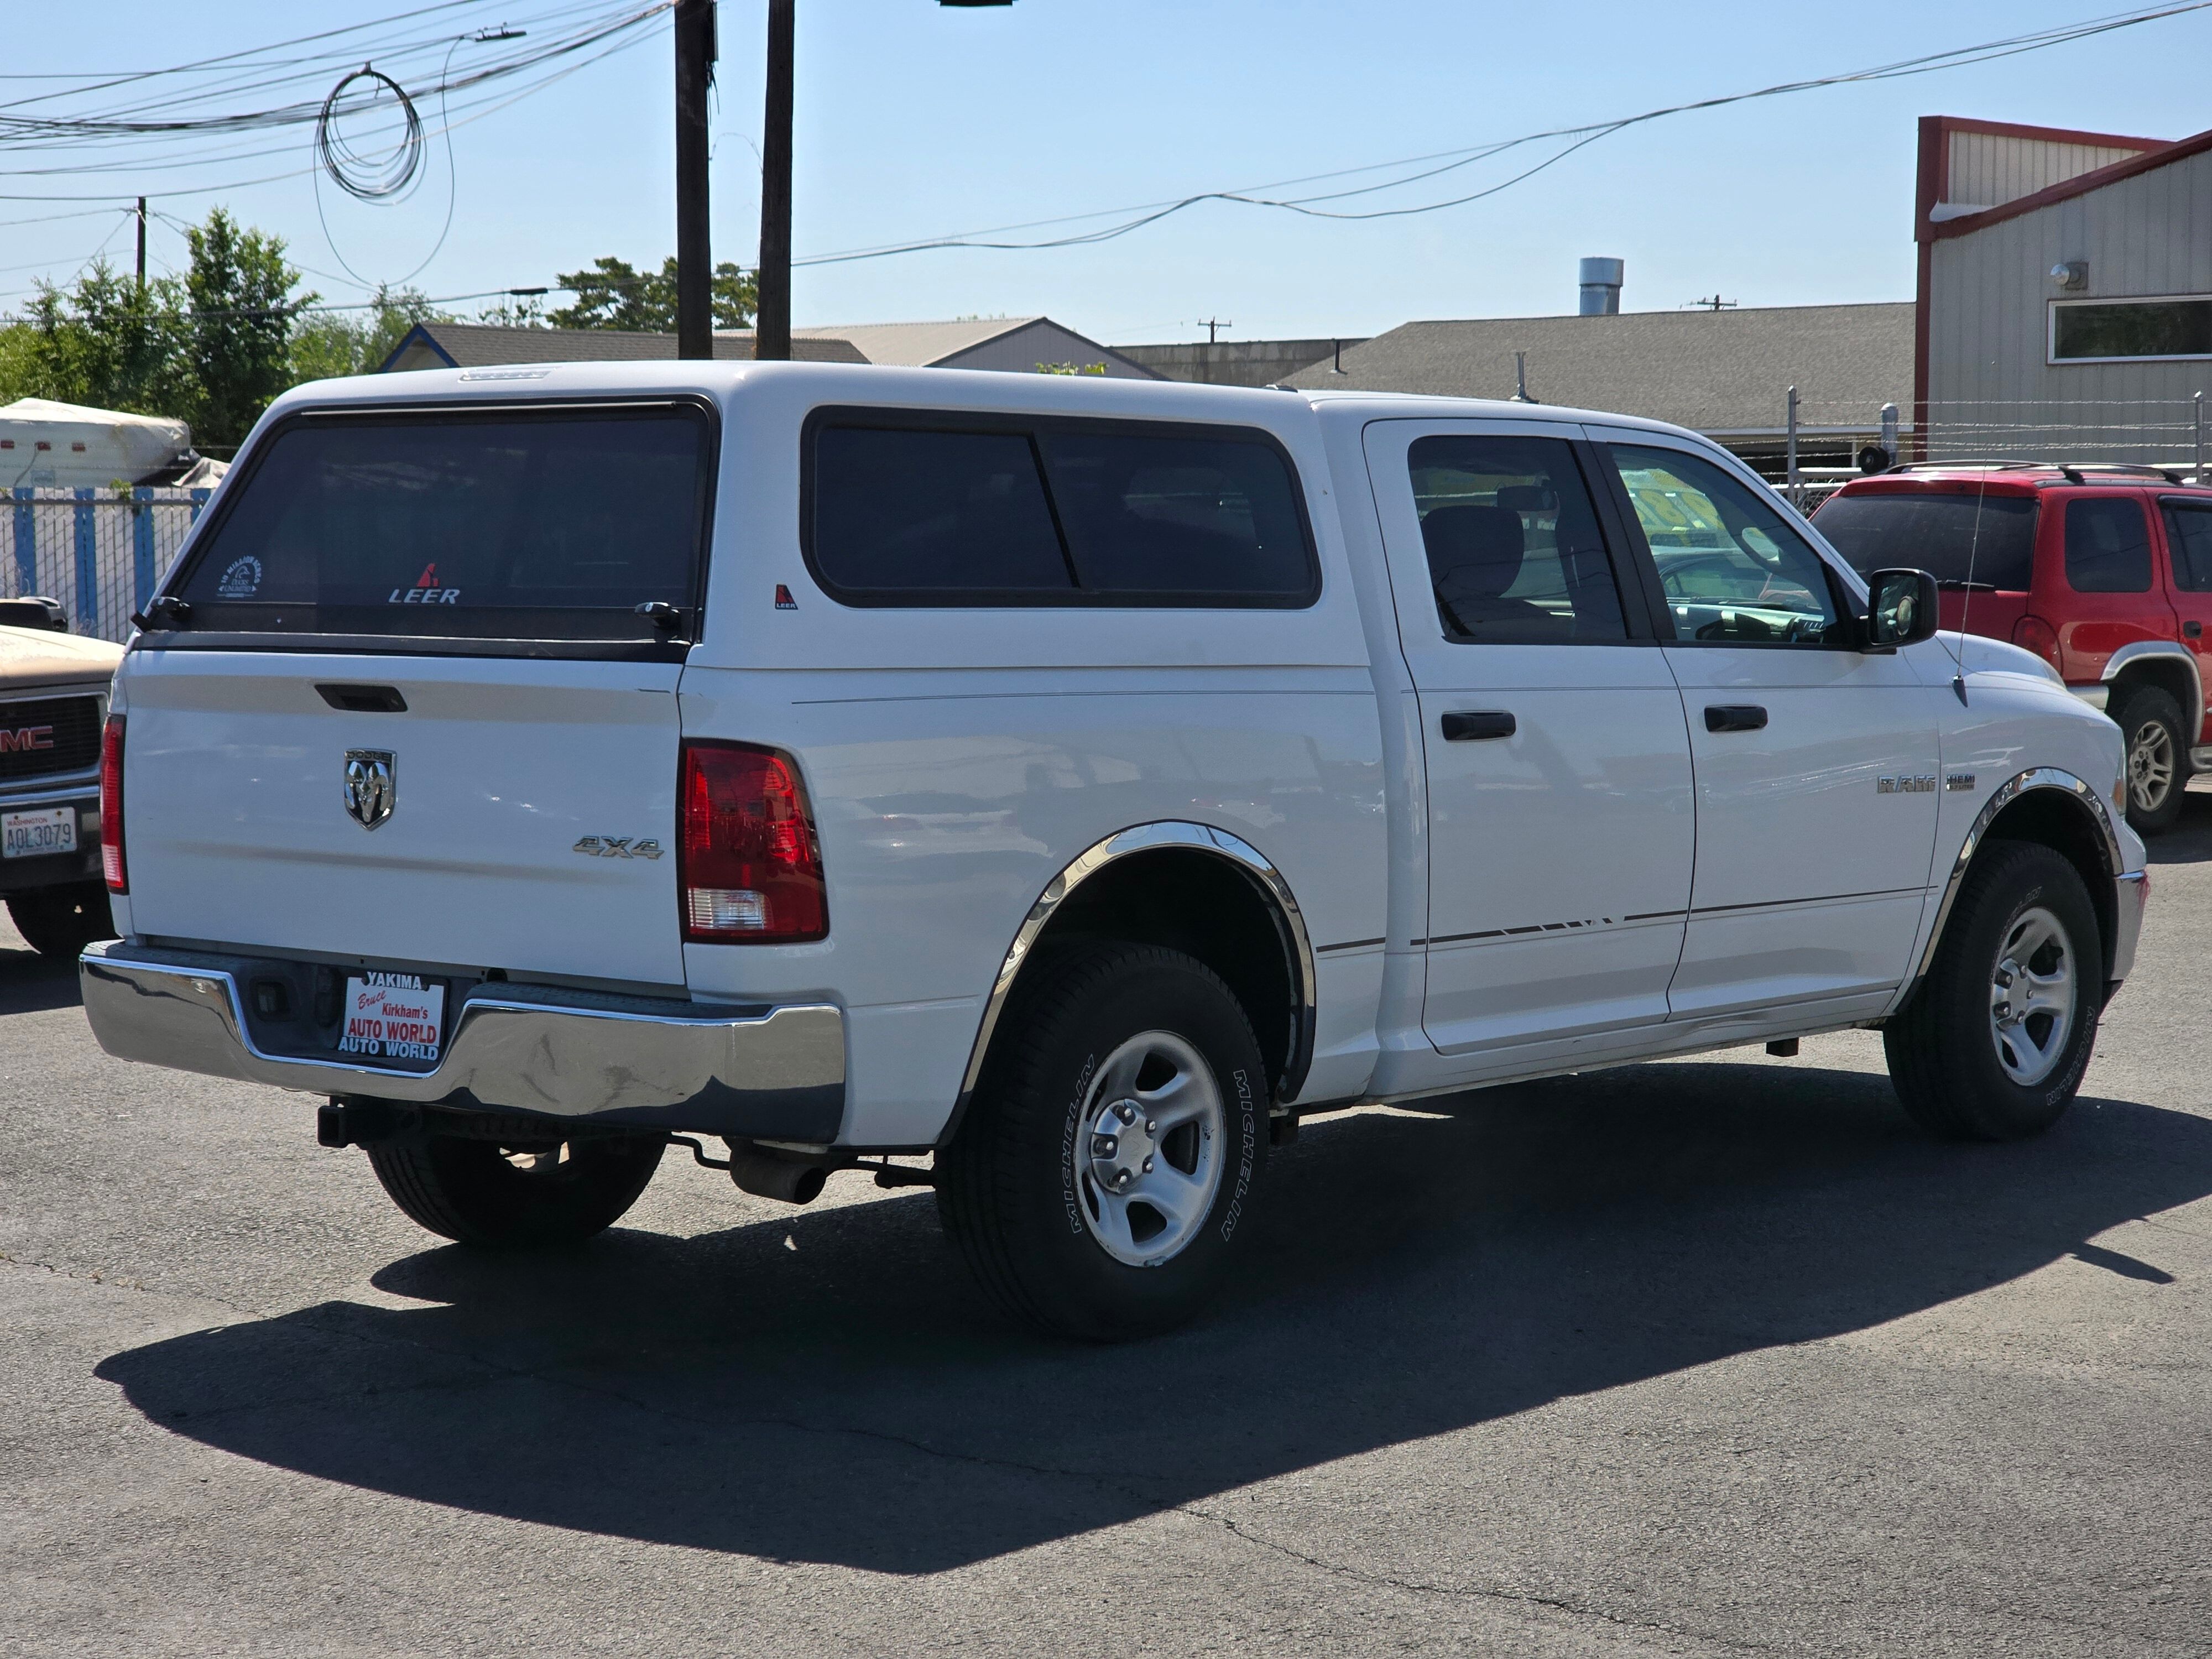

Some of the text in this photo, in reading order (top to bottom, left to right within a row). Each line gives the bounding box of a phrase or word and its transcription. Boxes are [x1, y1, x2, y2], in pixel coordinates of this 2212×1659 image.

[388, 589, 461, 604] LEER
[347, 752, 390, 761] DODGE
[1878, 775, 1936, 794] RAM
[1949, 774, 1975, 784] HEMI
[7, 817, 48, 826] WASHINGTON
[367, 972, 422, 990] YAKIMA
[357, 990, 387, 1010] Bruce
[382, 1002, 428, 1020] Kirkham's
[348, 1018, 436, 1044] AUTO WORLD
[338, 1036, 439, 1061] AUTO WORLD
[2046, 1006, 2096, 1106] MICHELIN
[1062, 1053, 1095, 1234] MICHELIN
[1220, 1069, 1255, 1242] MICHELIN
